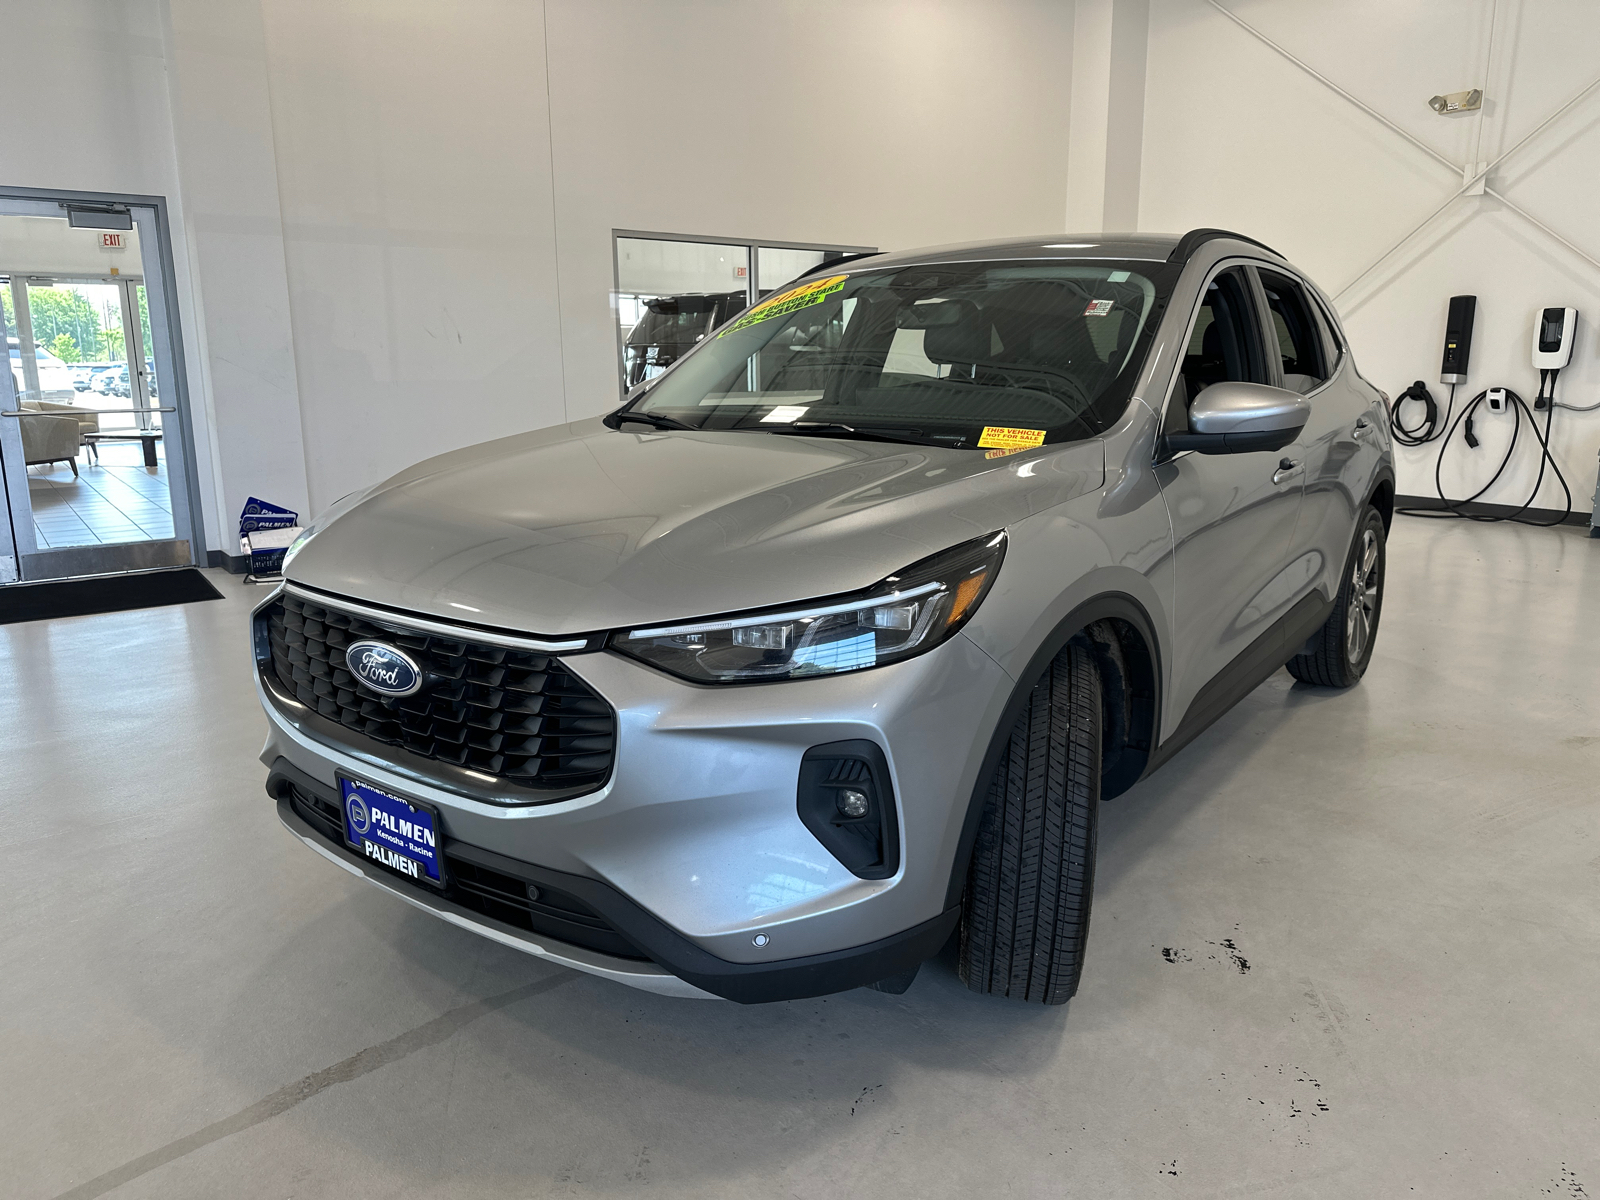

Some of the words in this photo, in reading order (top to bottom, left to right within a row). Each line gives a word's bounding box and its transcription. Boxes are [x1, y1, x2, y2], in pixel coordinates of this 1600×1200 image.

[103, 233, 120, 246] EXIT
[807, 282, 840, 298] START
[358, 651, 399, 686] Ford
[355, 780, 409, 806] palmen.com
[371, 807, 436, 847] PALMEN
[364, 840, 418, 878] PALMEN
[376, 828, 405, 847] Kenosha
[408, 842, 434, 859] Racine
